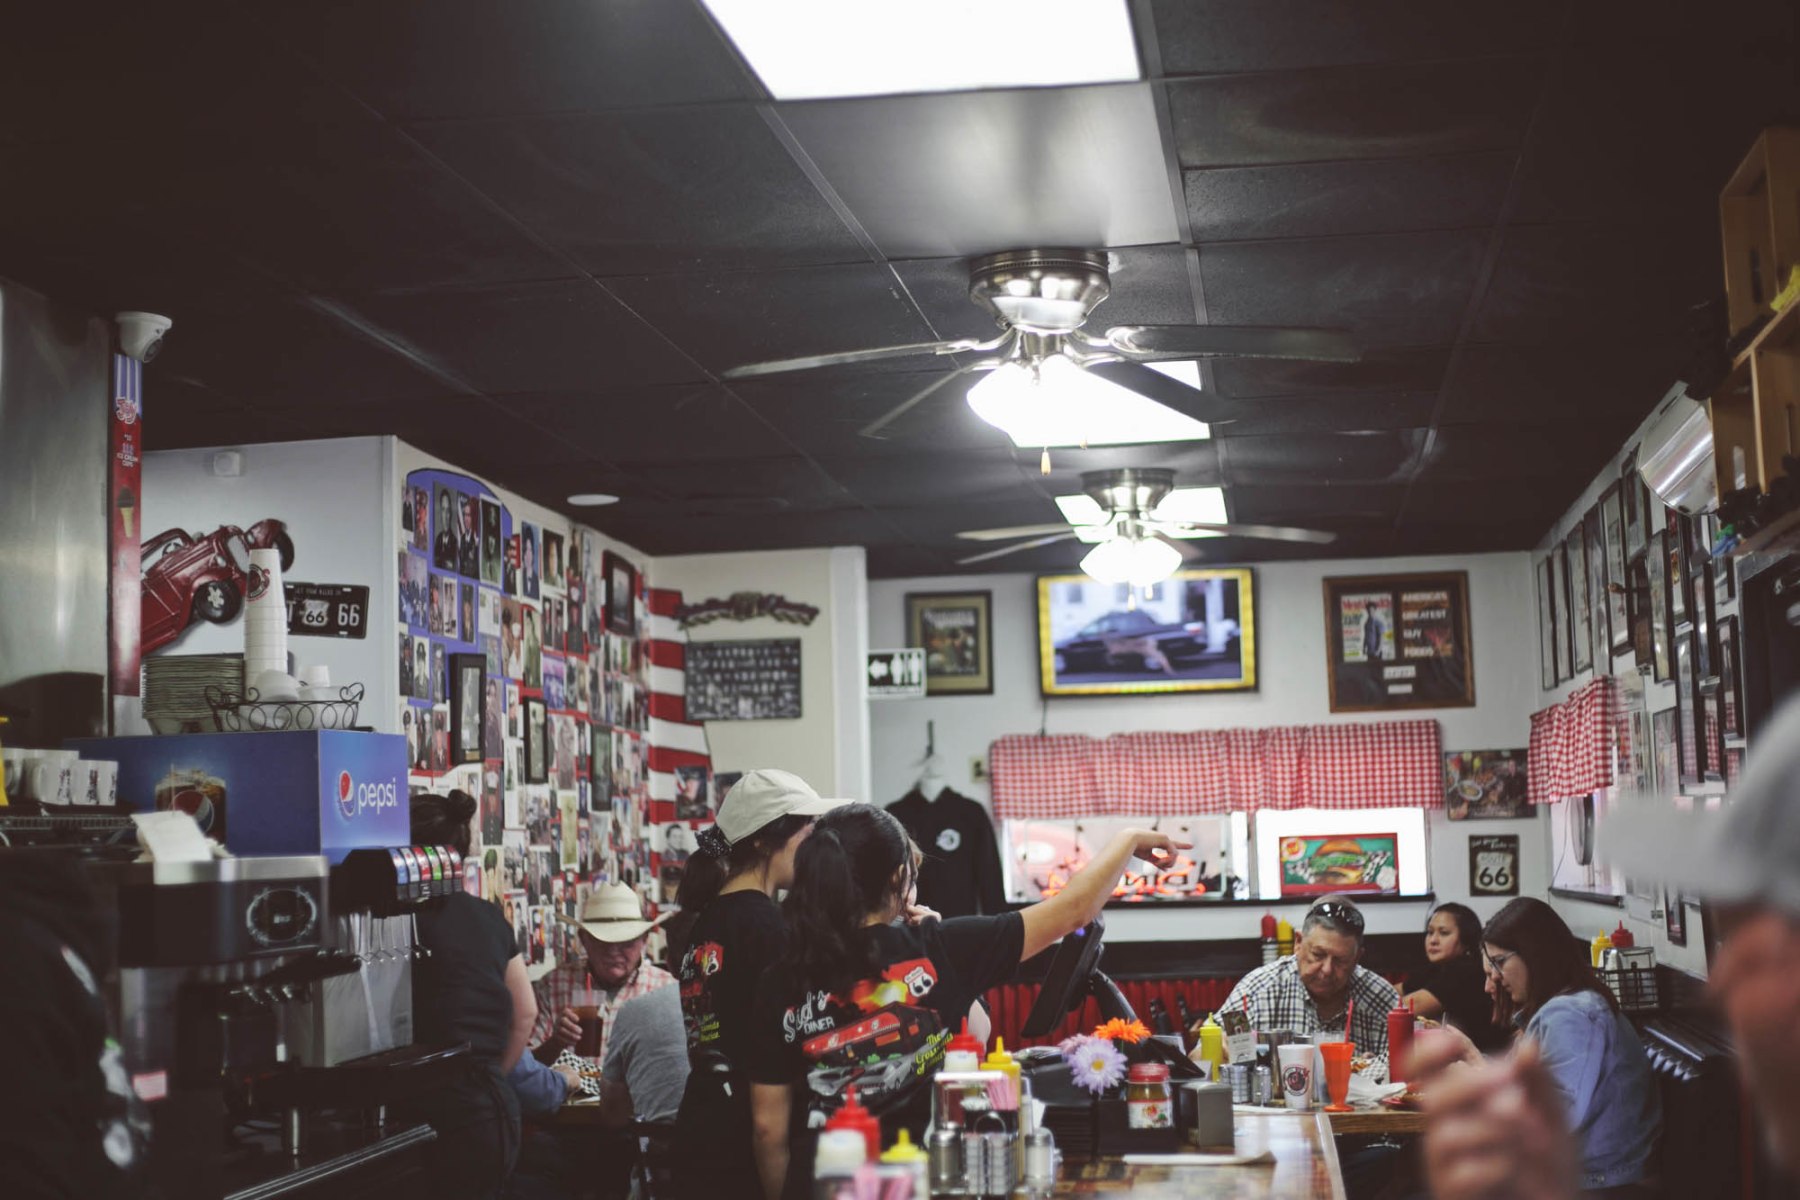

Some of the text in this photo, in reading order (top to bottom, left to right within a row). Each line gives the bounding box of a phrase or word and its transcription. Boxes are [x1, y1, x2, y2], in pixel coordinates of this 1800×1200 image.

[306, 610, 325, 623] 66
[337, 602, 360, 627] 66
[358, 777, 398, 815] pepsi
[1479, 866, 1510, 887] 66
[912, 975, 932, 994] 66
[782, 989, 831, 1043] Sid's
[803, 1016, 836, 1035] DINER
